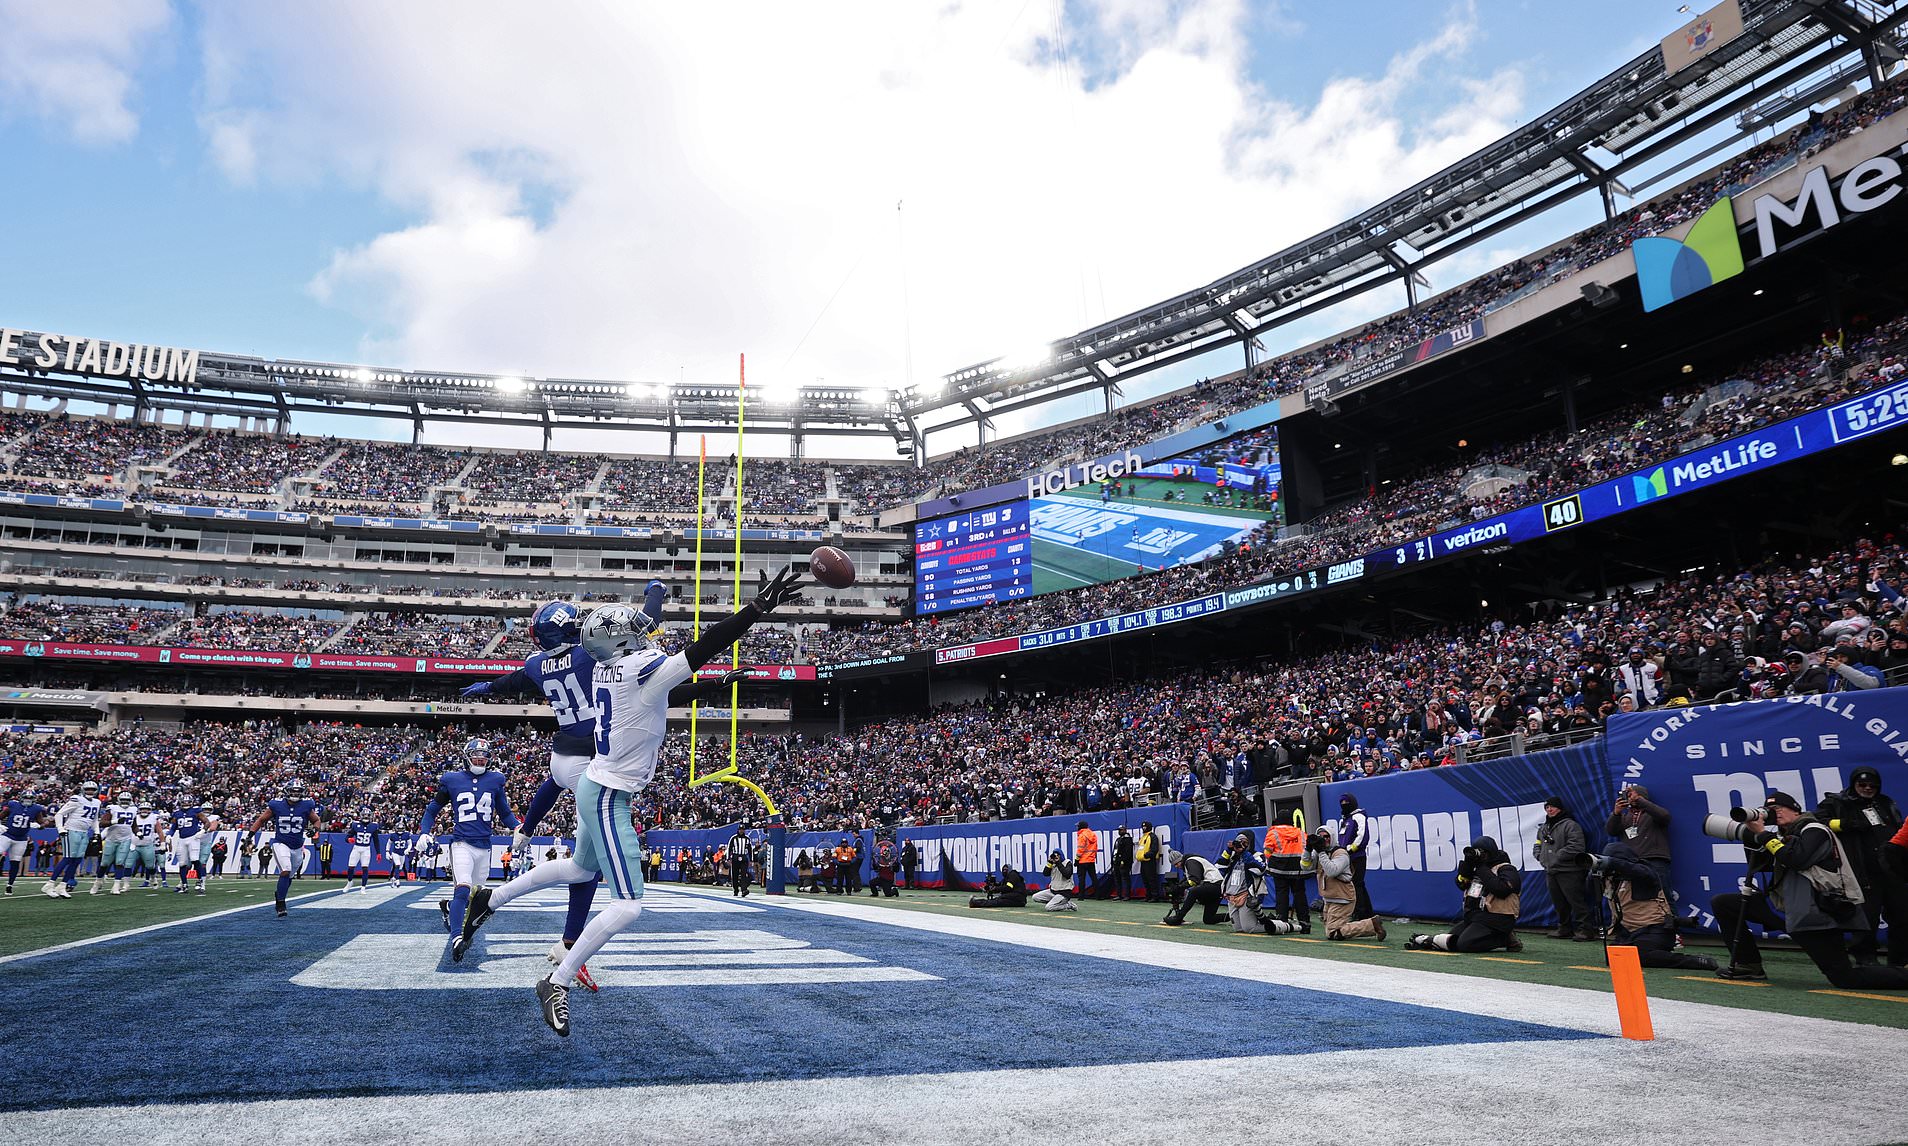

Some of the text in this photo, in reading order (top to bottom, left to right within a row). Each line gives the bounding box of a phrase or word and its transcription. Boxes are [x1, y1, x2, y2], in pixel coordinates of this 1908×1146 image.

[1754, 143, 1908, 258] Me
[35, 333, 200, 383] STADIUM
[1309, 382, 1328, 394] Need
[1672, 439, 1777, 487] MetLife
[1028, 450, 1142, 499] HCLTech
[1001, 508, 1012, 521] 3
[1549, 500, 1577, 526] 40
[1443, 520, 1507, 550] verizon
[1397, 548, 1406, 564] 3
[1417, 548, 1426, 561] 2
[1327, 558, 1365, 582] GIANTS
[1310, 577, 1317, 589] 3
[953, 587, 975, 595] RUSHING
[1008, 587, 1025, 596] 0/0
[1228, 576, 1302, 605] COWBOYS 0
[1161, 606, 1182, 621] 198.3
[1204, 598, 1220, 612] 19.4
[1095, 623, 1101, 634] 7
[1123, 615, 1142, 628] 104.1
[1038, 633, 1053, 645] 31.0
[1069, 629, 1075, 639] 9
[53, 647, 140, 659] Save time. Save money.
[319, 658, 398, 669] Save time. Save money.
[487, 663, 503, 671] with
[843, 661, 860, 669] DOWN
[860, 659, 872, 667] AND
[872, 657, 888, 665] GOAL
[888, 655, 905, 663] FROM
[31, 692, 86, 700] MetLife
[542, 672, 596, 727] 21
[436, 704, 462, 713] MetLife
[698, 709, 732, 719] HCLTec
[1638, 707, 1701, 752] YORK
[1685, 734, 1841, 760] SINCE
[1129, 783, 1141, 793] 82
[83, 805, 98, 820] 78
[456, 791, 492, 822] 24
[11, 814, 30, 829] 91
[117, 811, 133, 825] 52
[177, 817, 193, 828] 95
[277, 816, 303, 834] 53
[356, 832, 371, 844] 58
[394, 840, 406, 849] 33
[902, 839, 942, 872] EW
[943, 836, 989, 873] YORK
